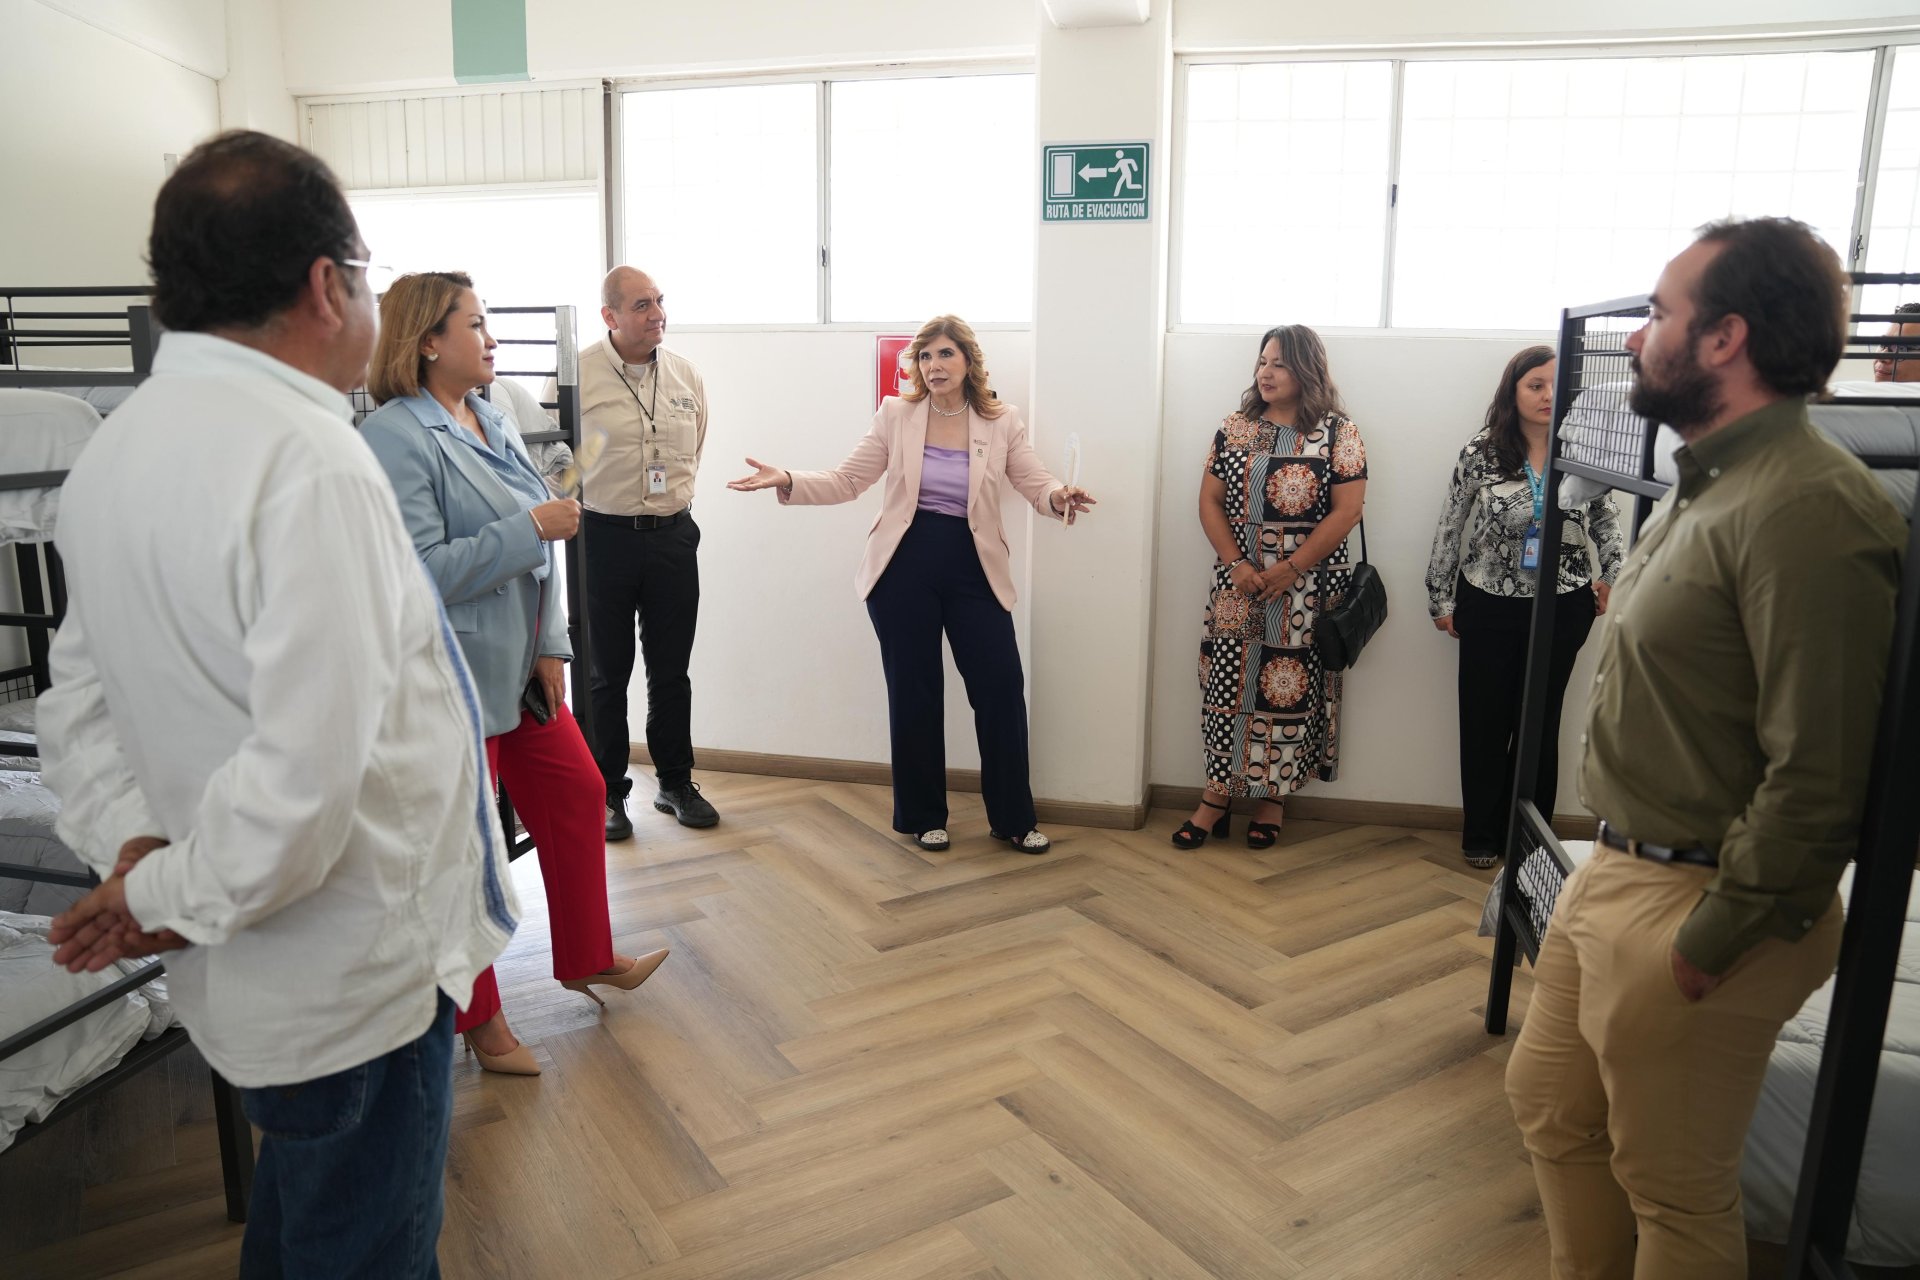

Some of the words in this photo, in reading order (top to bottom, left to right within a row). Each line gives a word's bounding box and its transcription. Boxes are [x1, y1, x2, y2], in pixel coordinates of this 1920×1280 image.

[1046, 204, 1070, 218] RUTA
[1072, 204, 1084, 218] DE
[1086, 203, 1145, 217] EVACUACION
